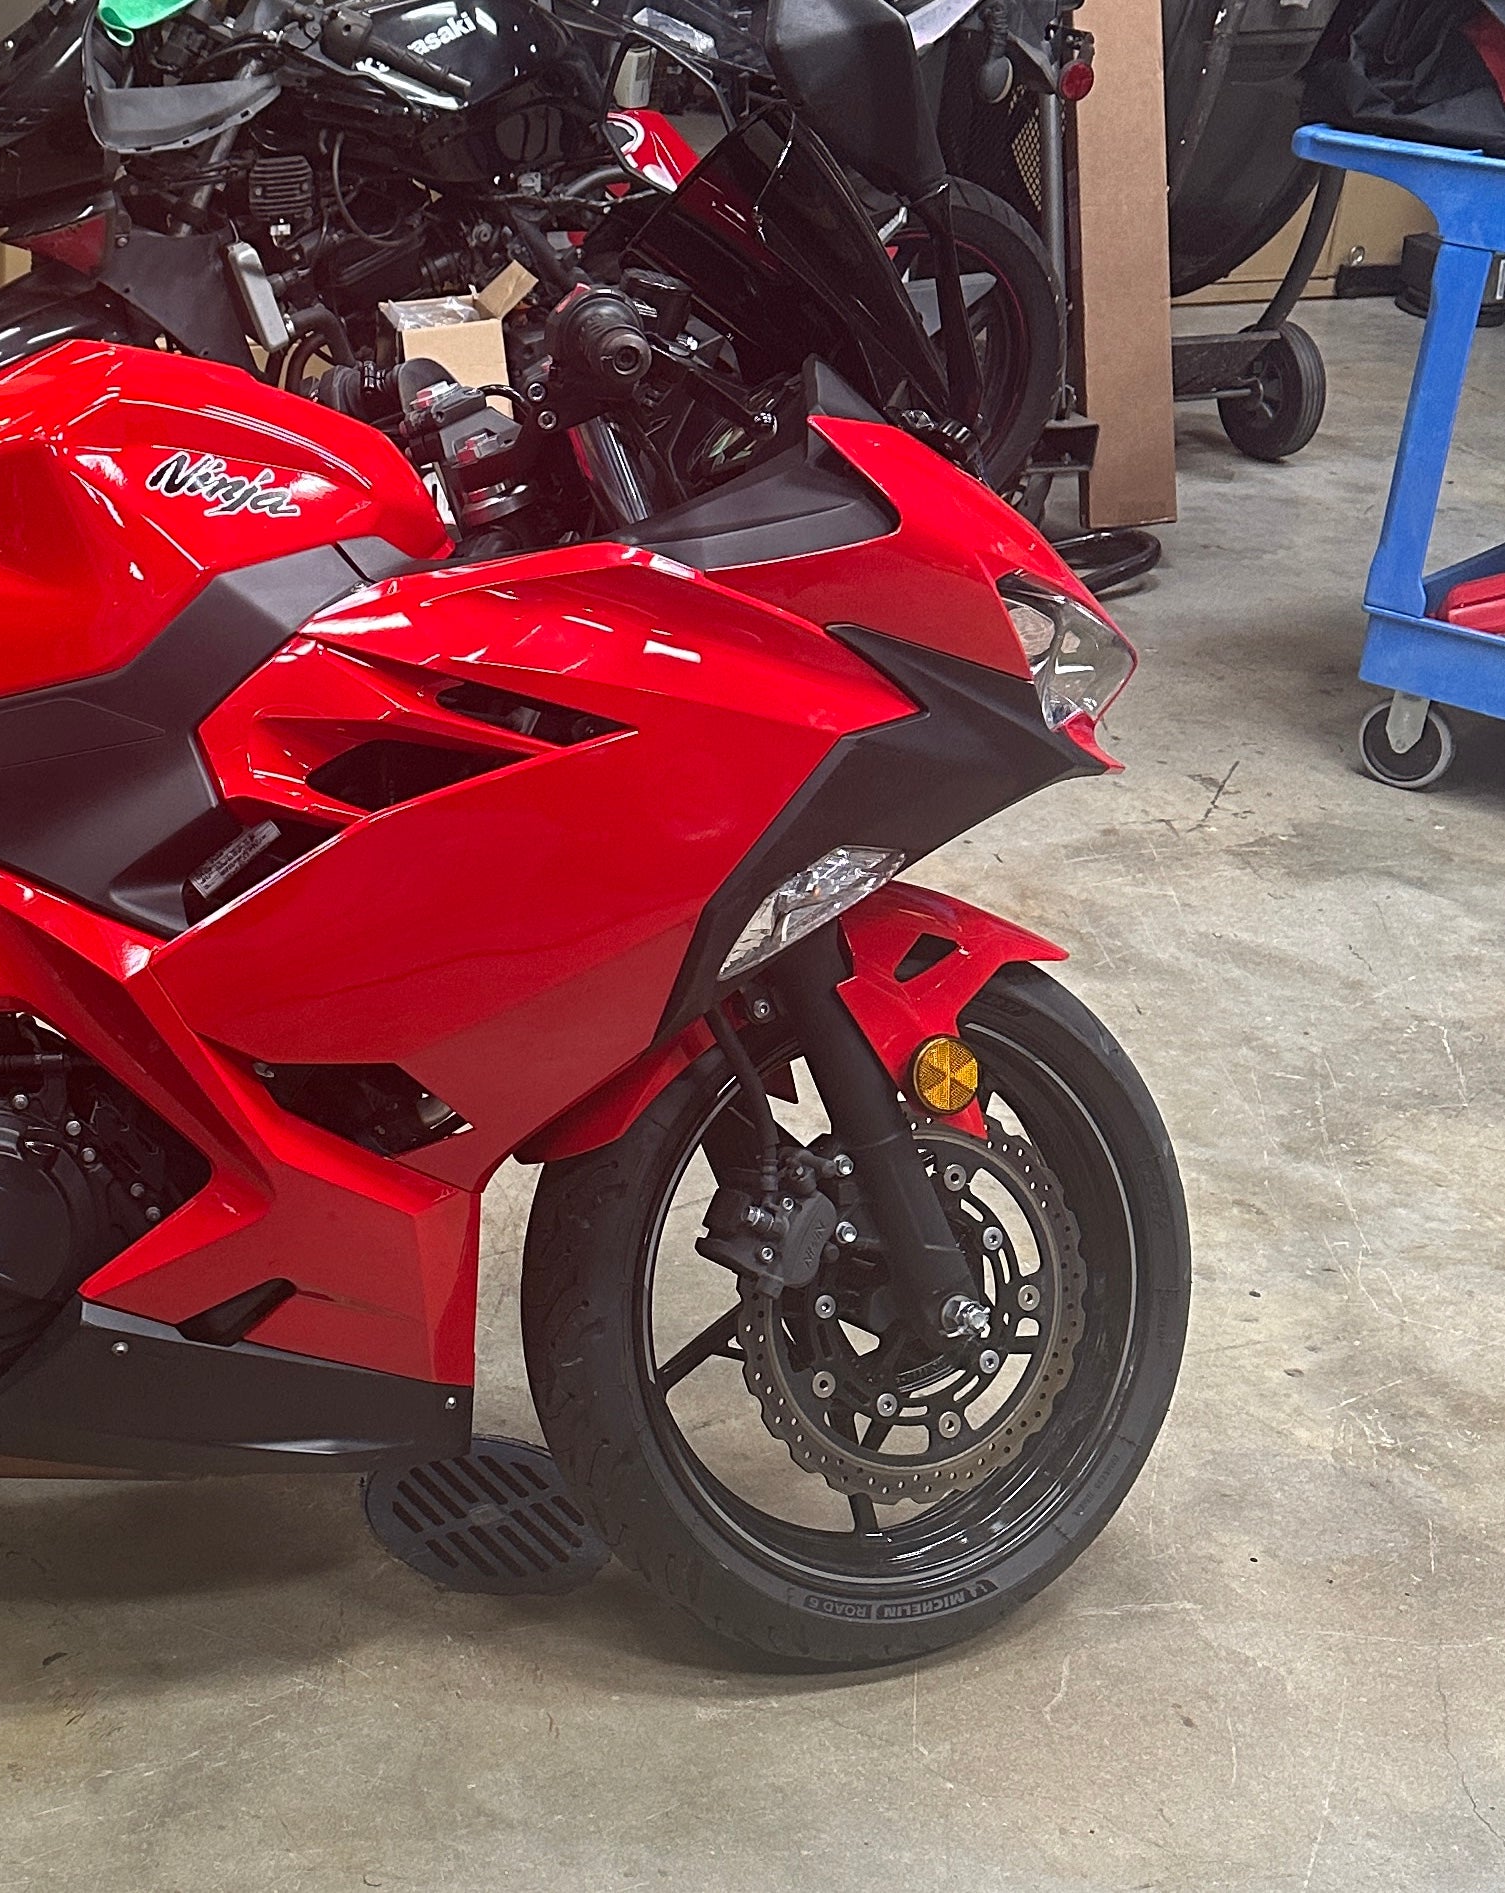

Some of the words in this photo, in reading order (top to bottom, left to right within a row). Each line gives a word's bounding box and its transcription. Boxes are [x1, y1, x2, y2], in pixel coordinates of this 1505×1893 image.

[355, 11, 476, 73] Kasaki
[145, 451, 301, 518] Ninja
[822, 1601, 868, 1618] ROAD
[882, 1588, 967, 1619] MICHELIN
